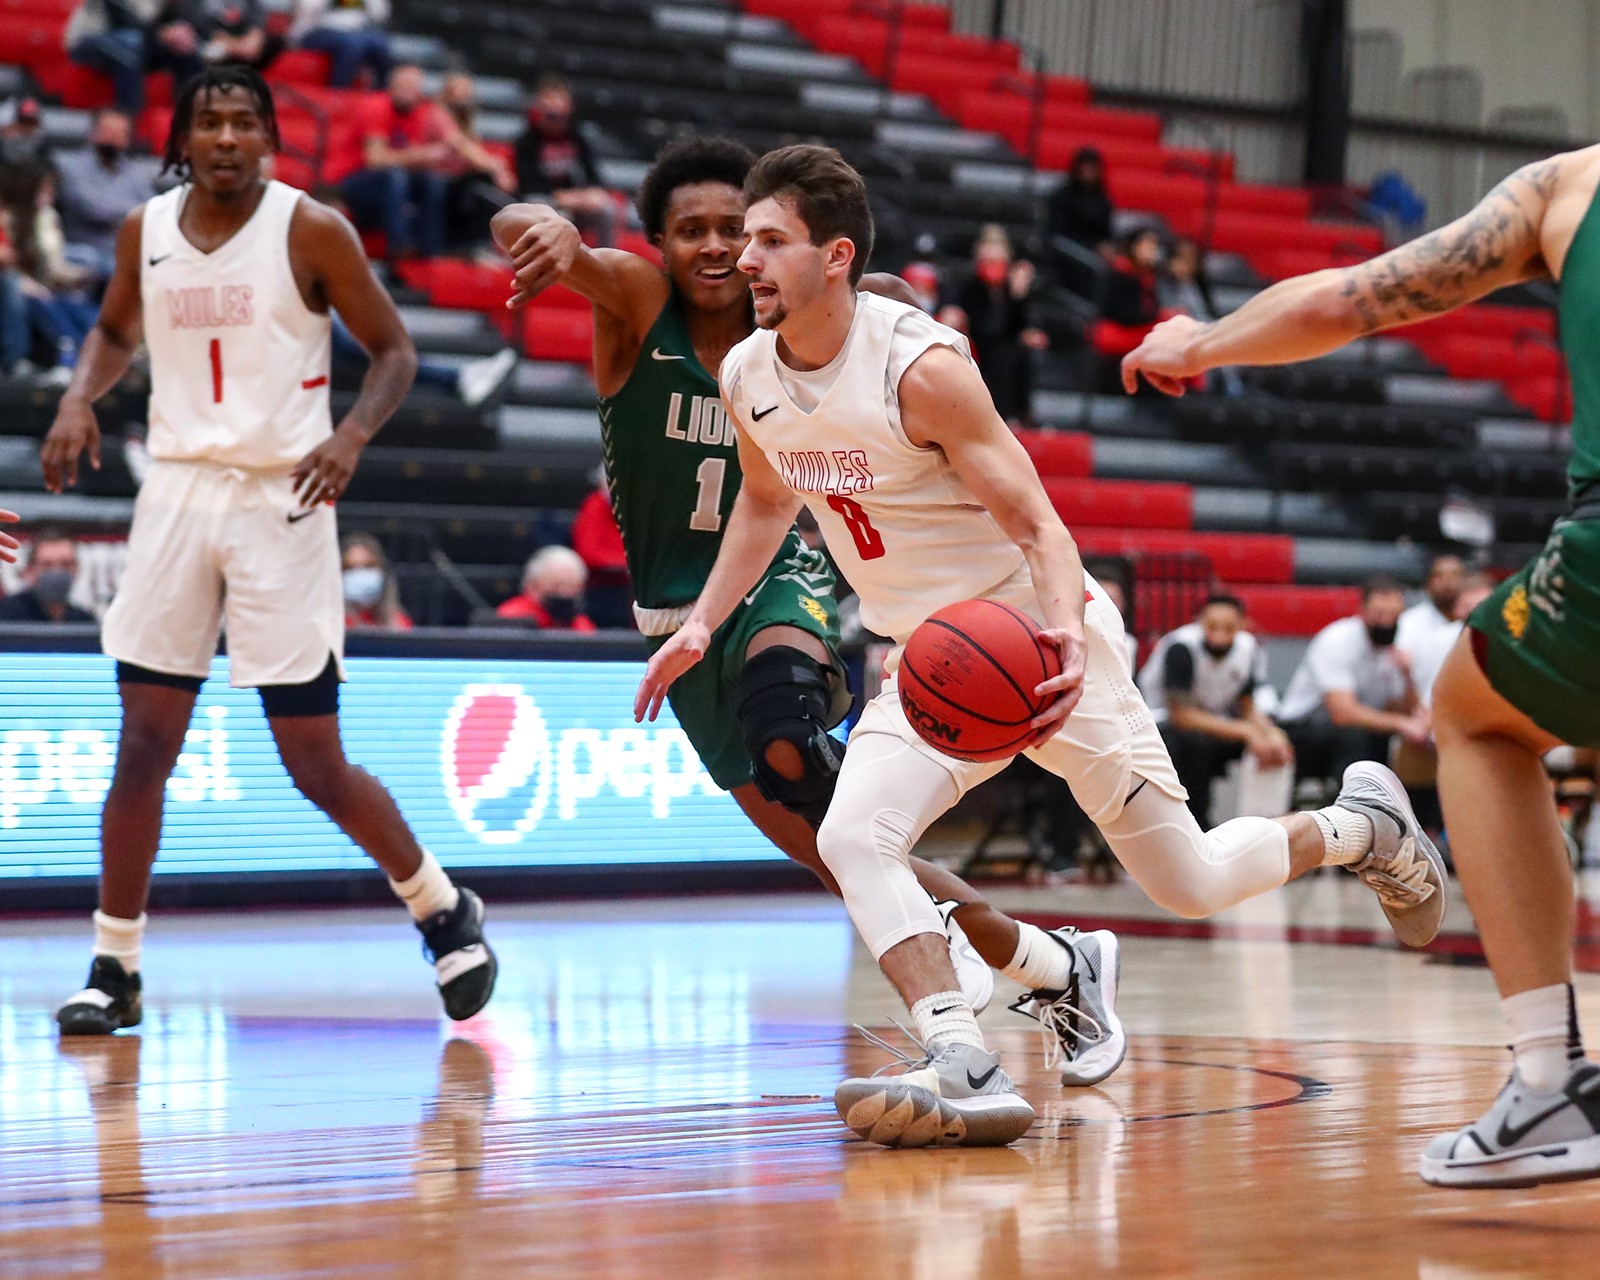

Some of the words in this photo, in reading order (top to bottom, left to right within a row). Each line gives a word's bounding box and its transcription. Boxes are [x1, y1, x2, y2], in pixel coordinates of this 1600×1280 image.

[165, 284, 253, 330] MULES
[209, 338, 223, 404] 1
[689, 457, 726, 531] 1
[778, 450, 874, 496] MULES
[0, 705, 243, 828] pesi
[557, 728, 731, 820] pep
